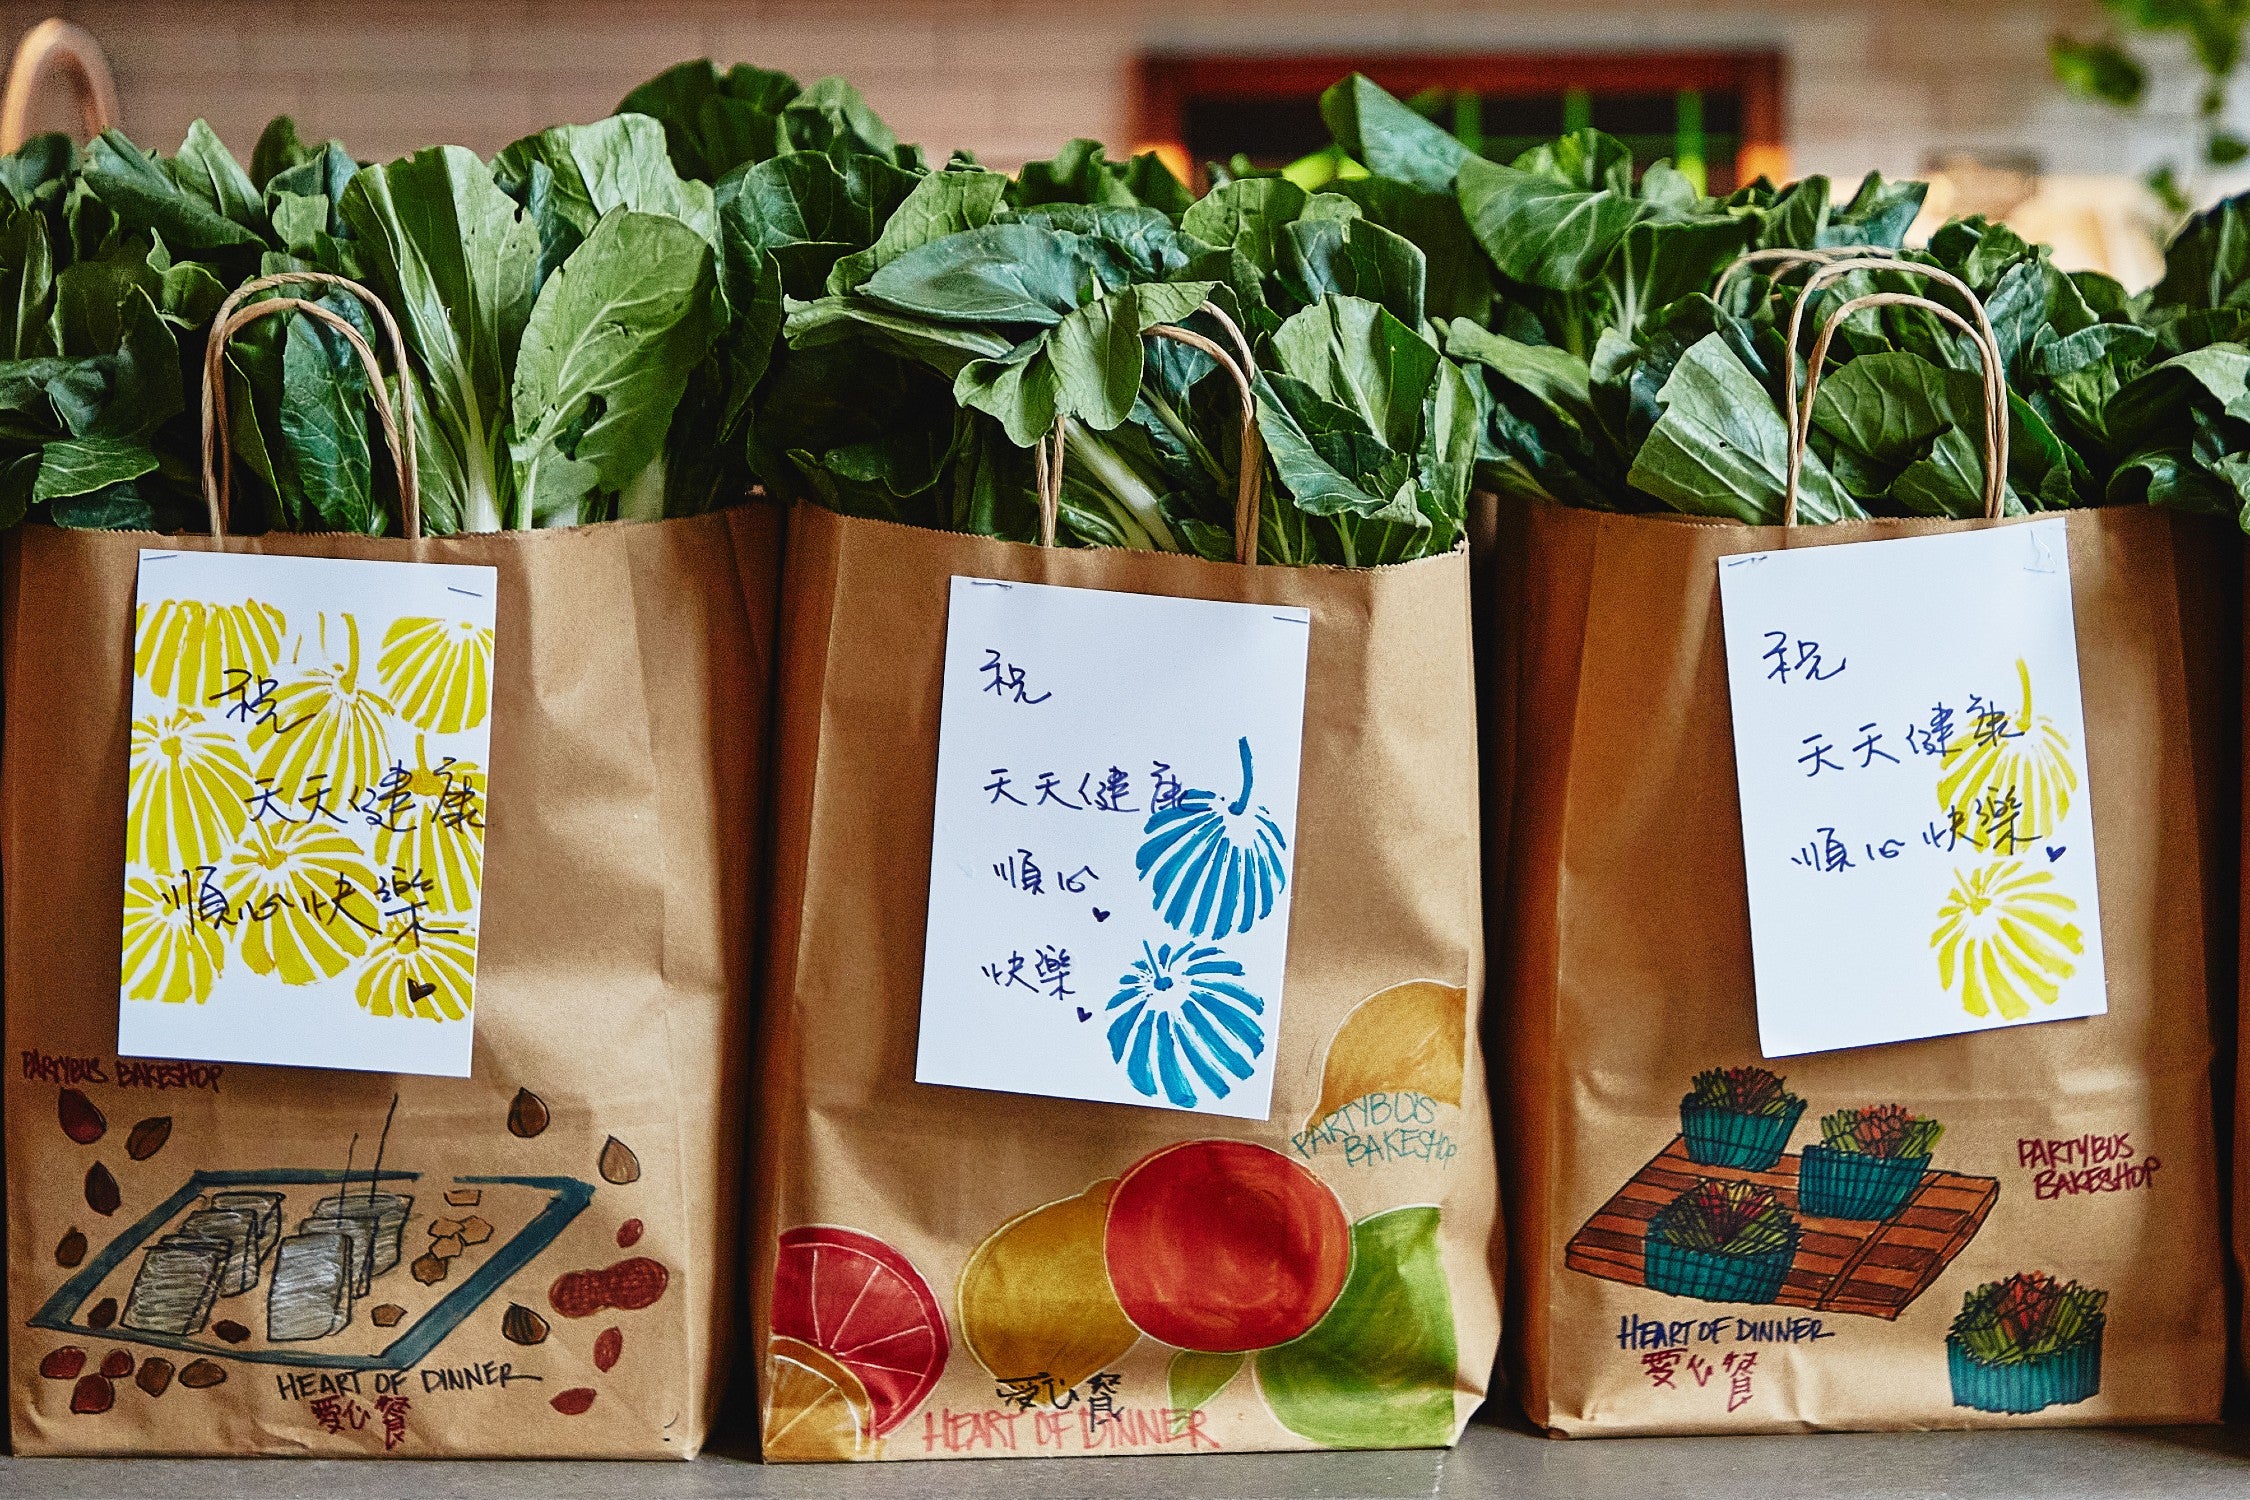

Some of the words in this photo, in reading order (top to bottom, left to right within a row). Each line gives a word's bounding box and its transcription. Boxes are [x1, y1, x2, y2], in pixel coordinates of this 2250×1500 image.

[979, 649, 1051, 704] 祝
[1763, 631, 1846, 684] 祝
[209, 669, 318, 733] 祝
[245, 758, 485, 833] 天天健康
[984, 760, 1188, 813] 天天健康
[1791, 785, 2042, 873] 順心快樂
[992, 848, 1099, 895] 順心
[161, 866, 459, 947] 順心快樂
[981, 945, 1076, 1000] 快樂
[22, 1049, 109, 1085] PARTYBUS
[115, 1061, 223, 1093] BAKESHOP
[1292, 1092, 1437, 1160] PARTYBUS
[2018, 1133, 2135, 1168] PARTYBUS
[2034, 1156, 2161, 1200] BAKESHOP
[1616, 1313, 1696, 1350] HEART
[1696, 1315, 1733, 1344] OF
[1735, 1316, 1834, 1343] DINNER
[277, 1371, 361, 1400] HEART
[374, 1370, 407, 1395] OF
[422, 1361, 543, 1393] DINNER
[923, 1409, 1019, 1452] HEART
[1034, 1411, 1069, 1449] OF
[1083, 1409, 1221, 1449] DINNER
